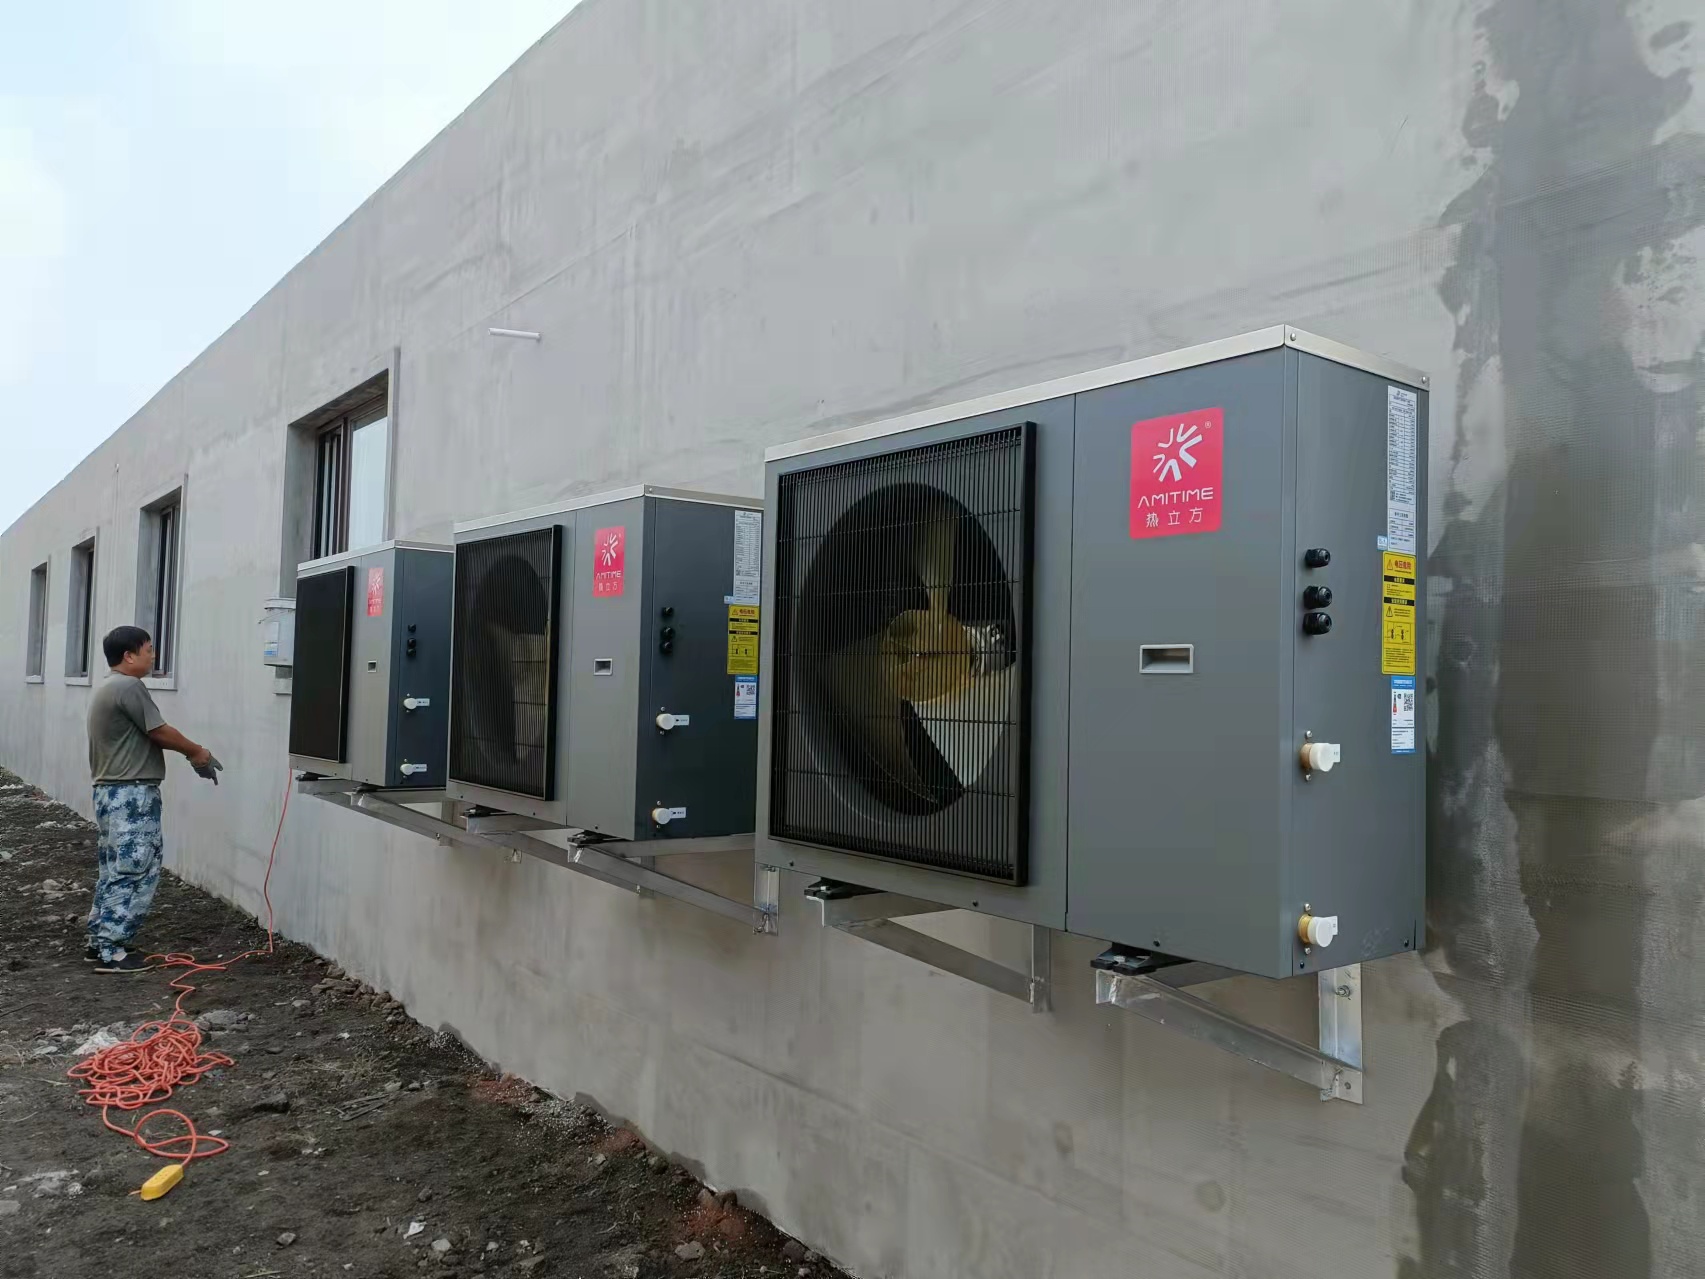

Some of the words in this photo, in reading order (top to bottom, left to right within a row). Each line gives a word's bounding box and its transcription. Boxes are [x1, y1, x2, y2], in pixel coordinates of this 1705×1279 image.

[1137, 487, 1214, 509] AMITIME
[1145, 506, 1204, 529] 热立方
